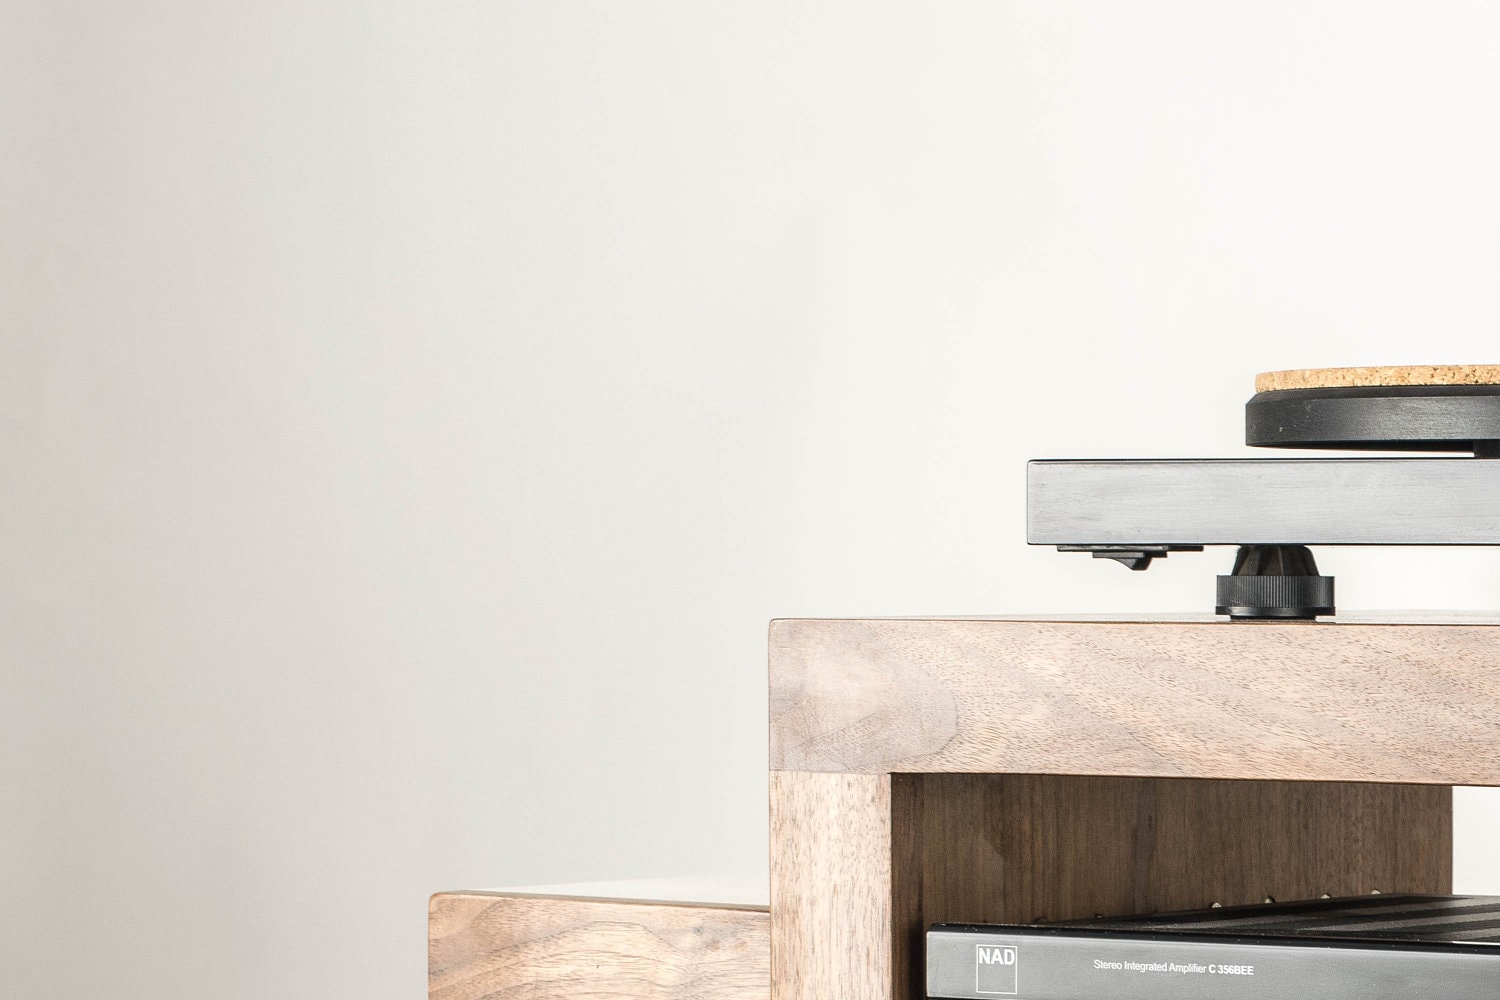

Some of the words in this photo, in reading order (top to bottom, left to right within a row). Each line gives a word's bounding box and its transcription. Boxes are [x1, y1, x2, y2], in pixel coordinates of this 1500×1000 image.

[978, 948, 1017, 966] NAD
[1094, 959, 1122, 971] Stereo
[1124, 960, 1167, 974] Integrated
[1168, 962, 1207, 975] Amplifier
[1208, 964, 1216, 973] C
[1217, 964, 1255, 976] 356BEE
